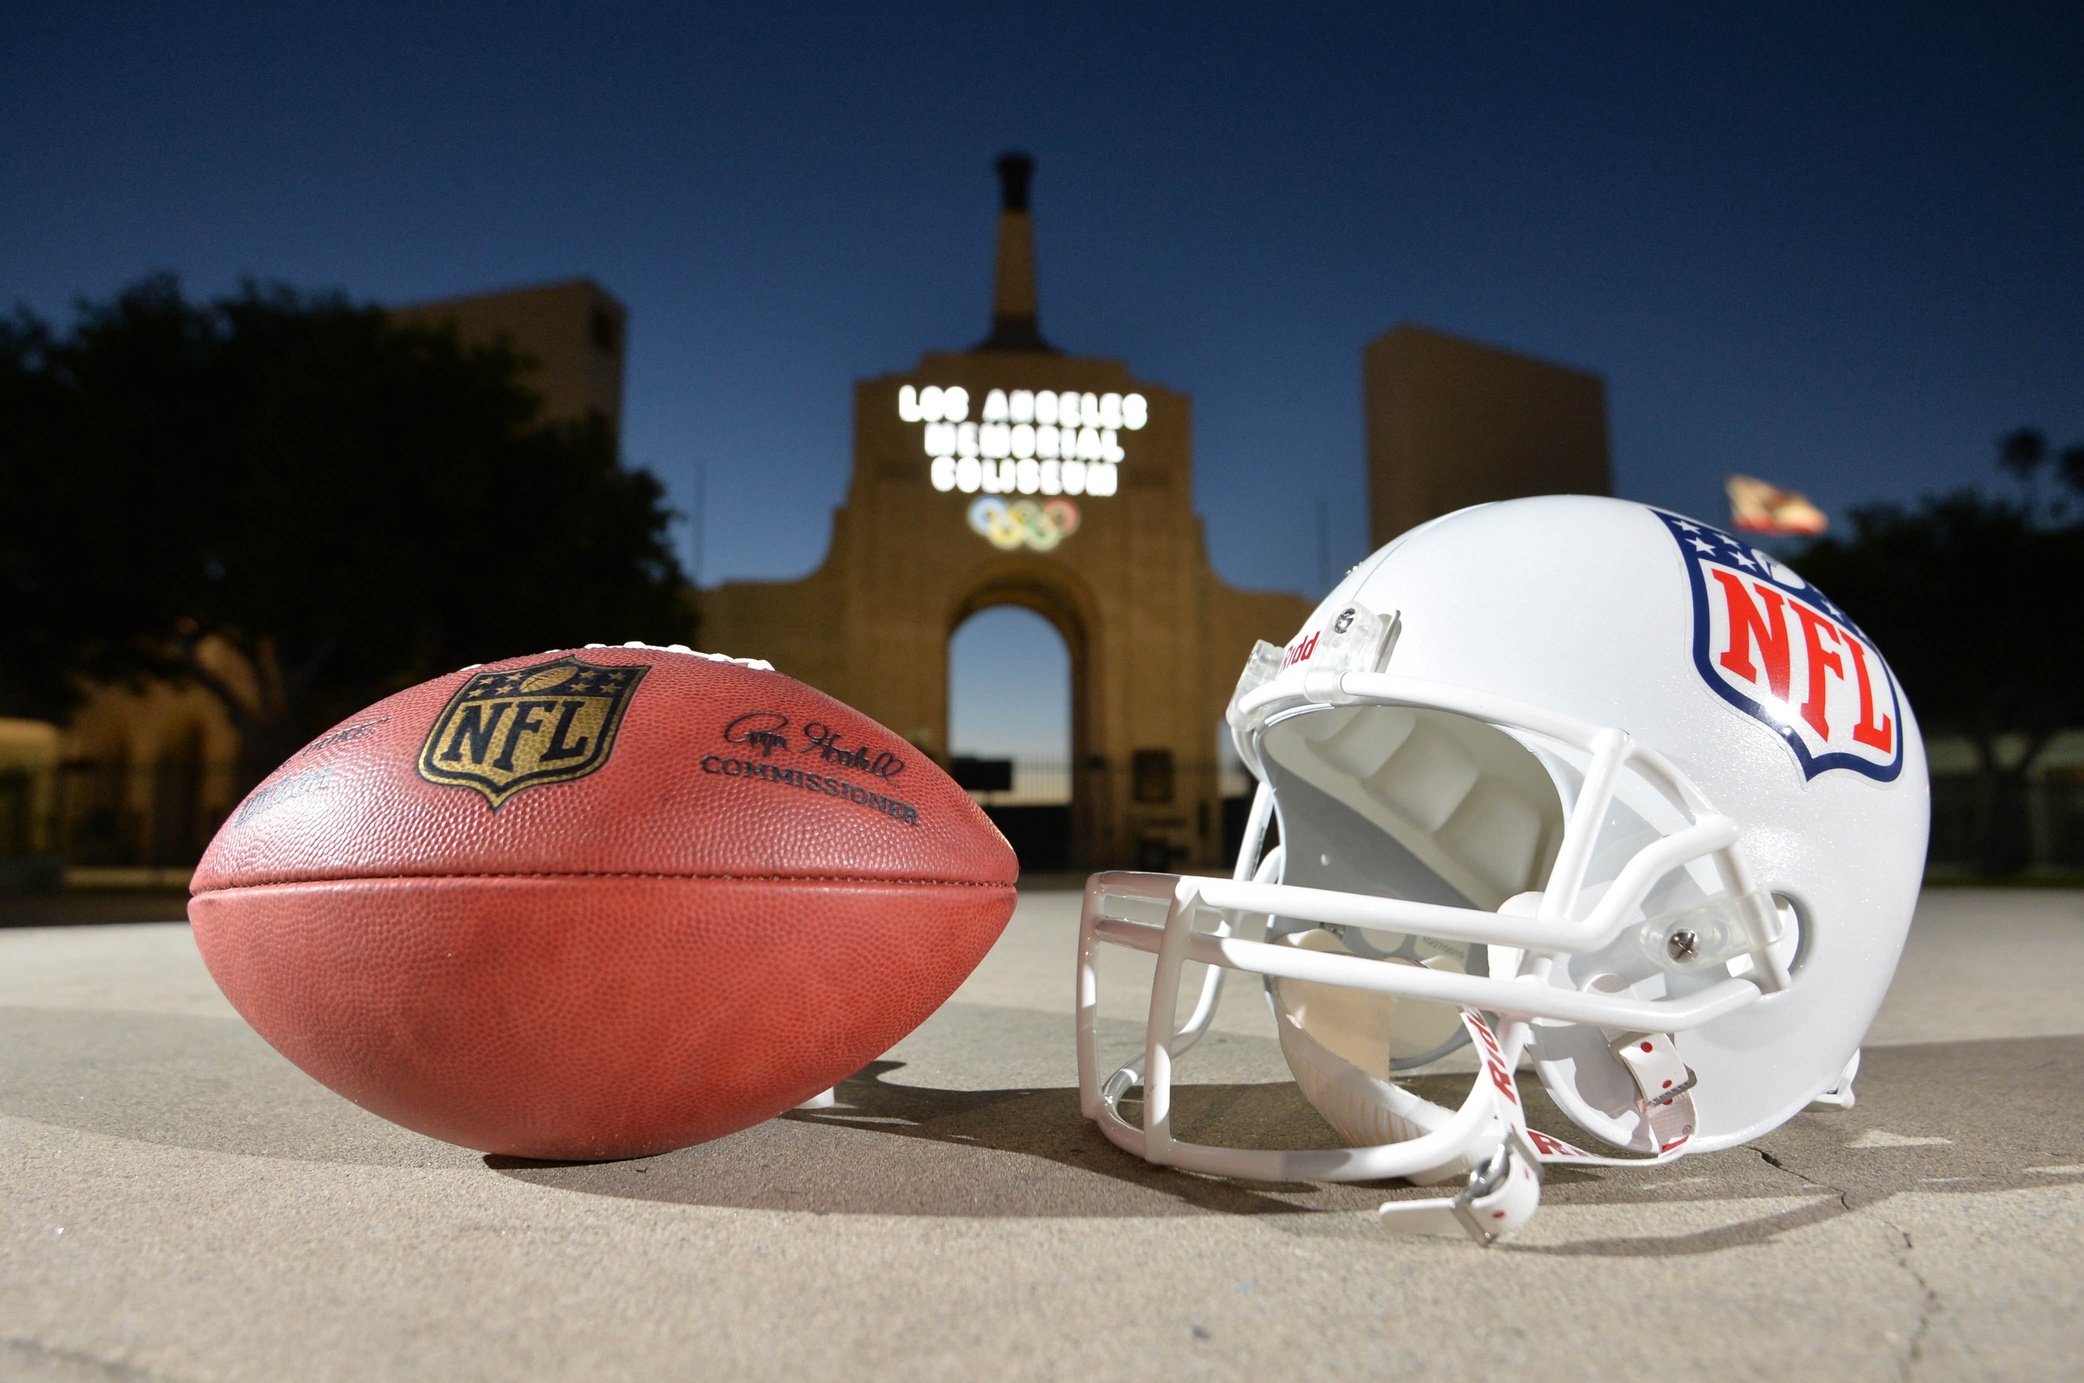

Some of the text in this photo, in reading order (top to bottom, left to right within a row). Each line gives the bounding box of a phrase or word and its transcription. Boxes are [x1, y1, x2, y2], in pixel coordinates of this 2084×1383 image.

[899, 384, 1148, 430] LOS ANGELES
[1710, 567, 1892, 755] NFL
[439, 700, 589, 773] NFL
[701, 755, 919, 827] COMMISSIONER
